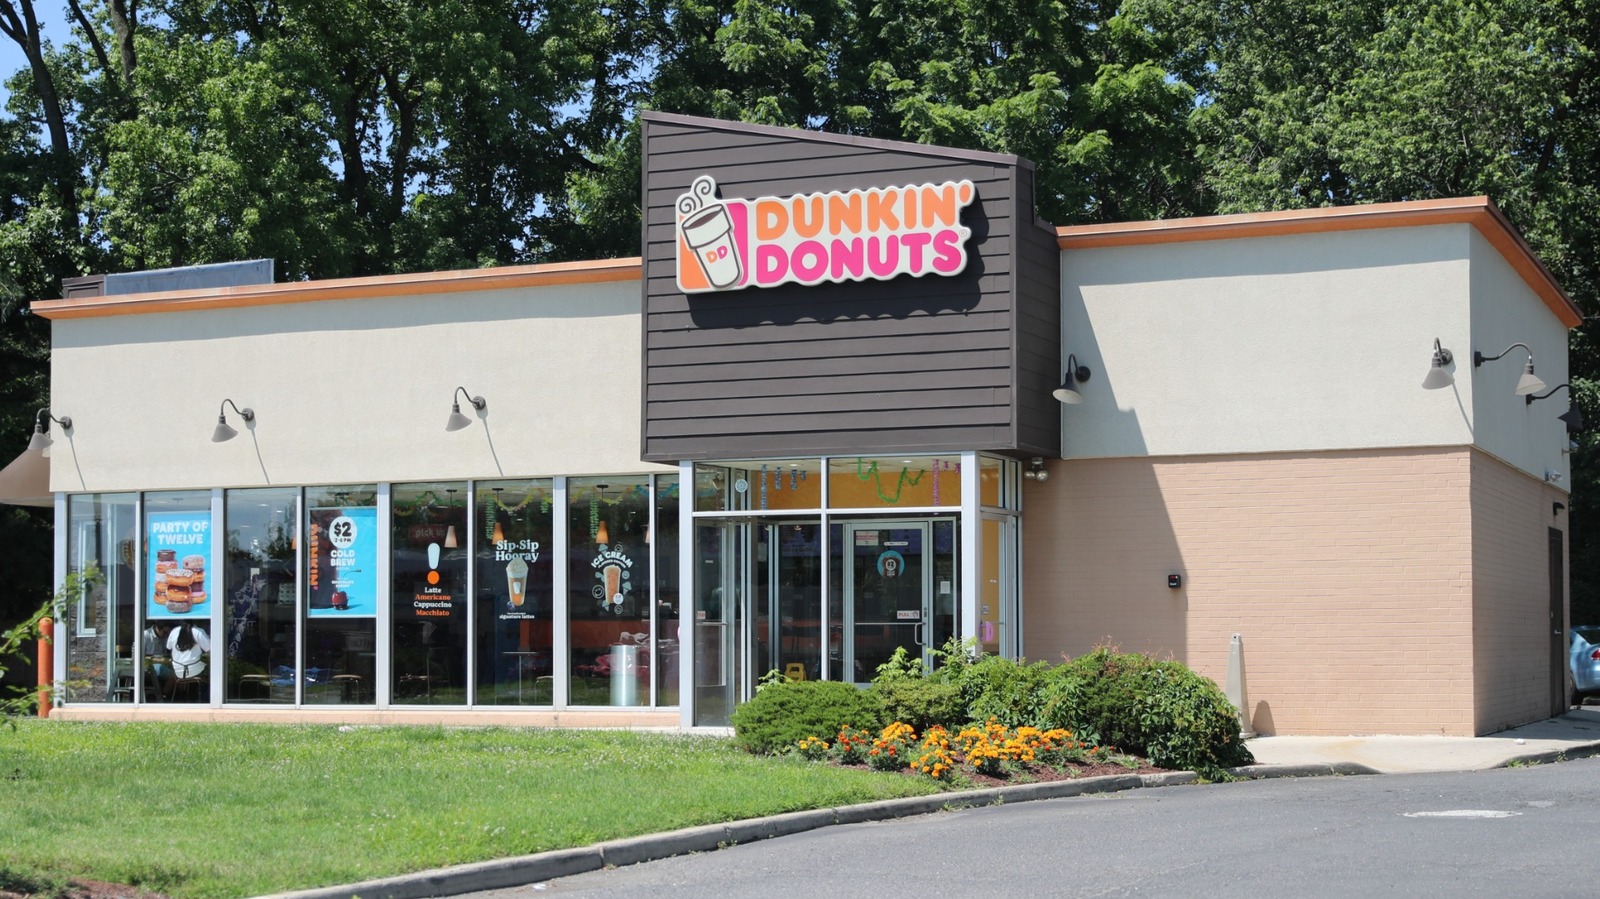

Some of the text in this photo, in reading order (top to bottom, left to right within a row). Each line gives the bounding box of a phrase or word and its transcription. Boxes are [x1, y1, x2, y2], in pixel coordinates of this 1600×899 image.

[756, 184, 970, 241] DUNKIN'
[756, 229, 962, 284] DONUTS
[153, 521, 209, 533] PARTY OF
[334, 521, 353, 537] $2
[157, 533, 204, 545] TWELVE
[330, 549, 355, 558] COLD
[495, 551, 539, 563] Hooray
[590, 554, 605, 568] ICE
[604, 551, 633, 568] CREAM
[330, 558, 356, 567] BREW
[424, 586, 442, 594] Latte
[413, 601, 453, 609] Cappuccino
